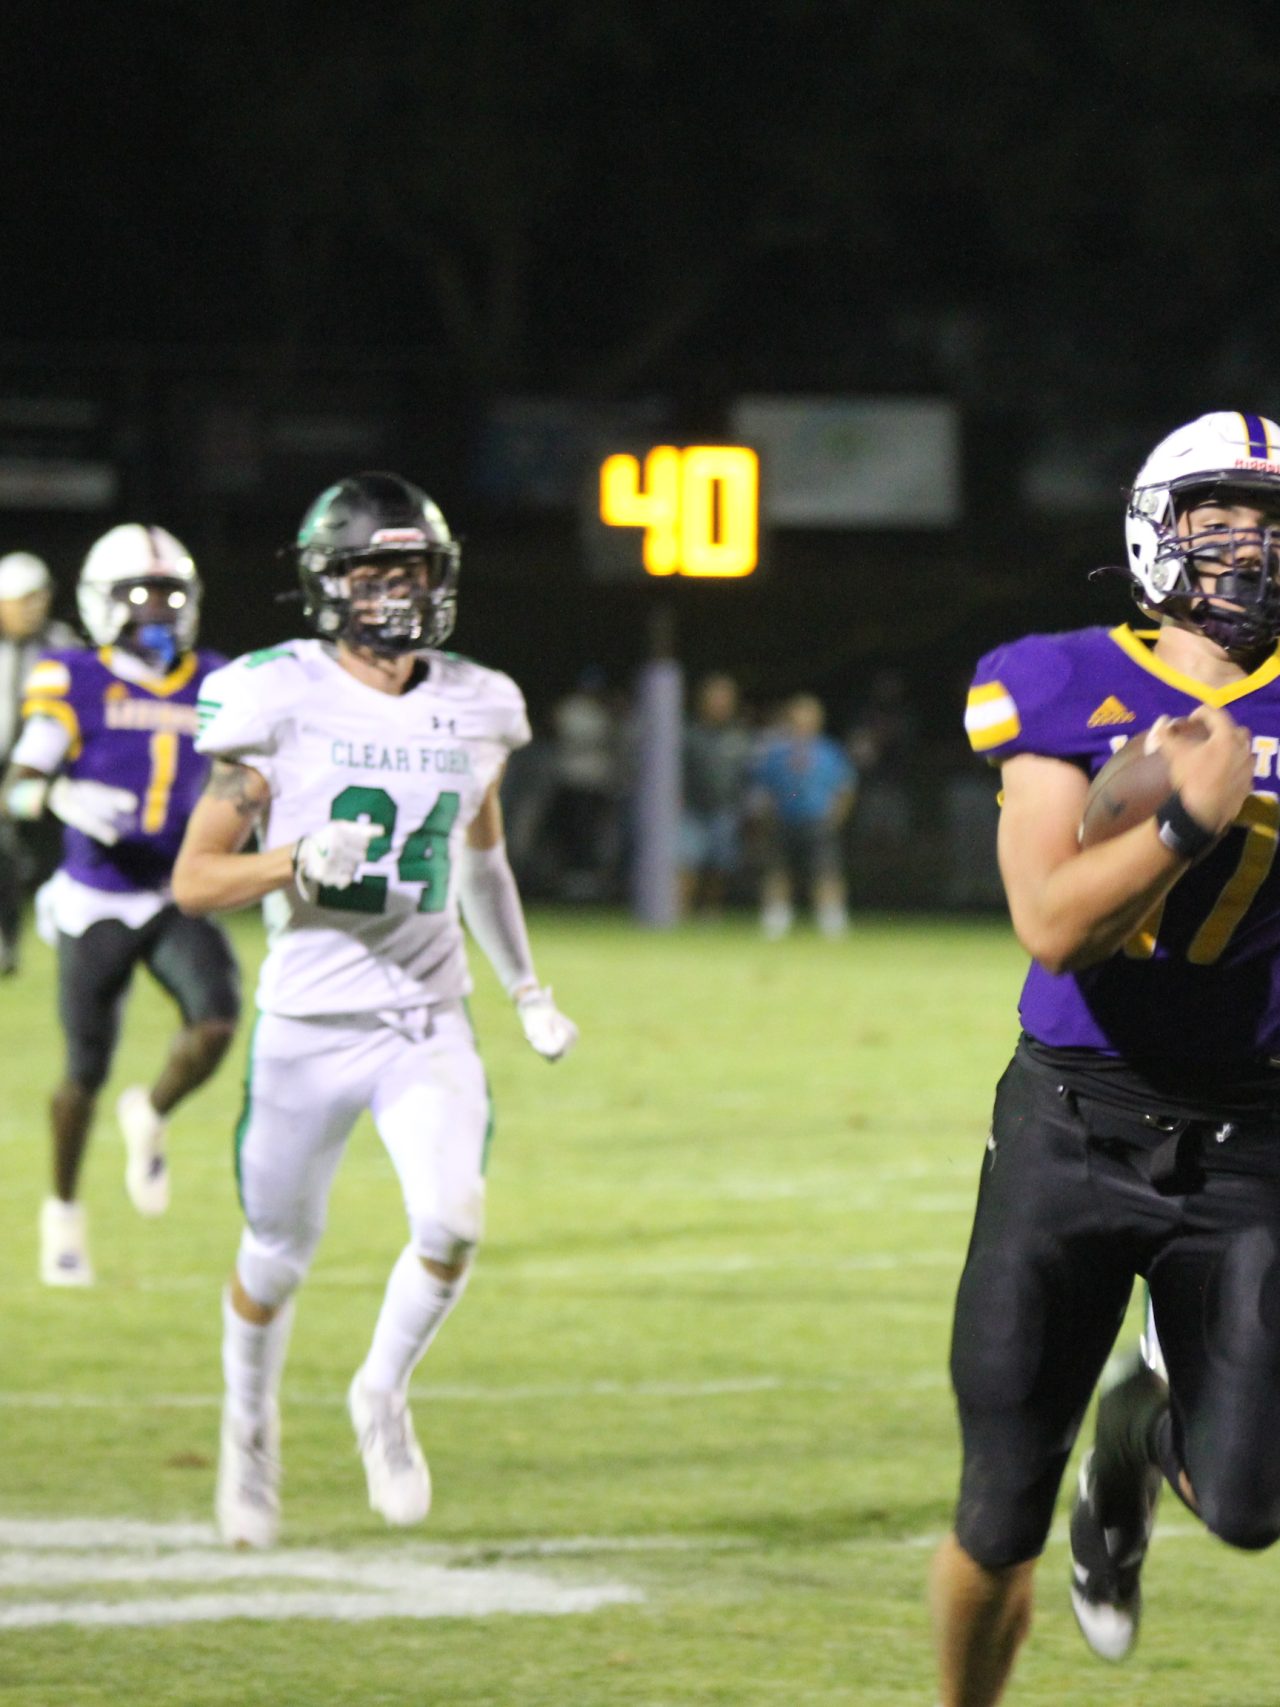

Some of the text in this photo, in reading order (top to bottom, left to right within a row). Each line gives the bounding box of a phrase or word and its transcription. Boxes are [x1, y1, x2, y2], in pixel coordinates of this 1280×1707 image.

[599, 445, 759, 577] 40
[141, 729, 180, 835] 1
[331, 740, 410, 772] CLEAR
[316, 785, 460, 914] 24
